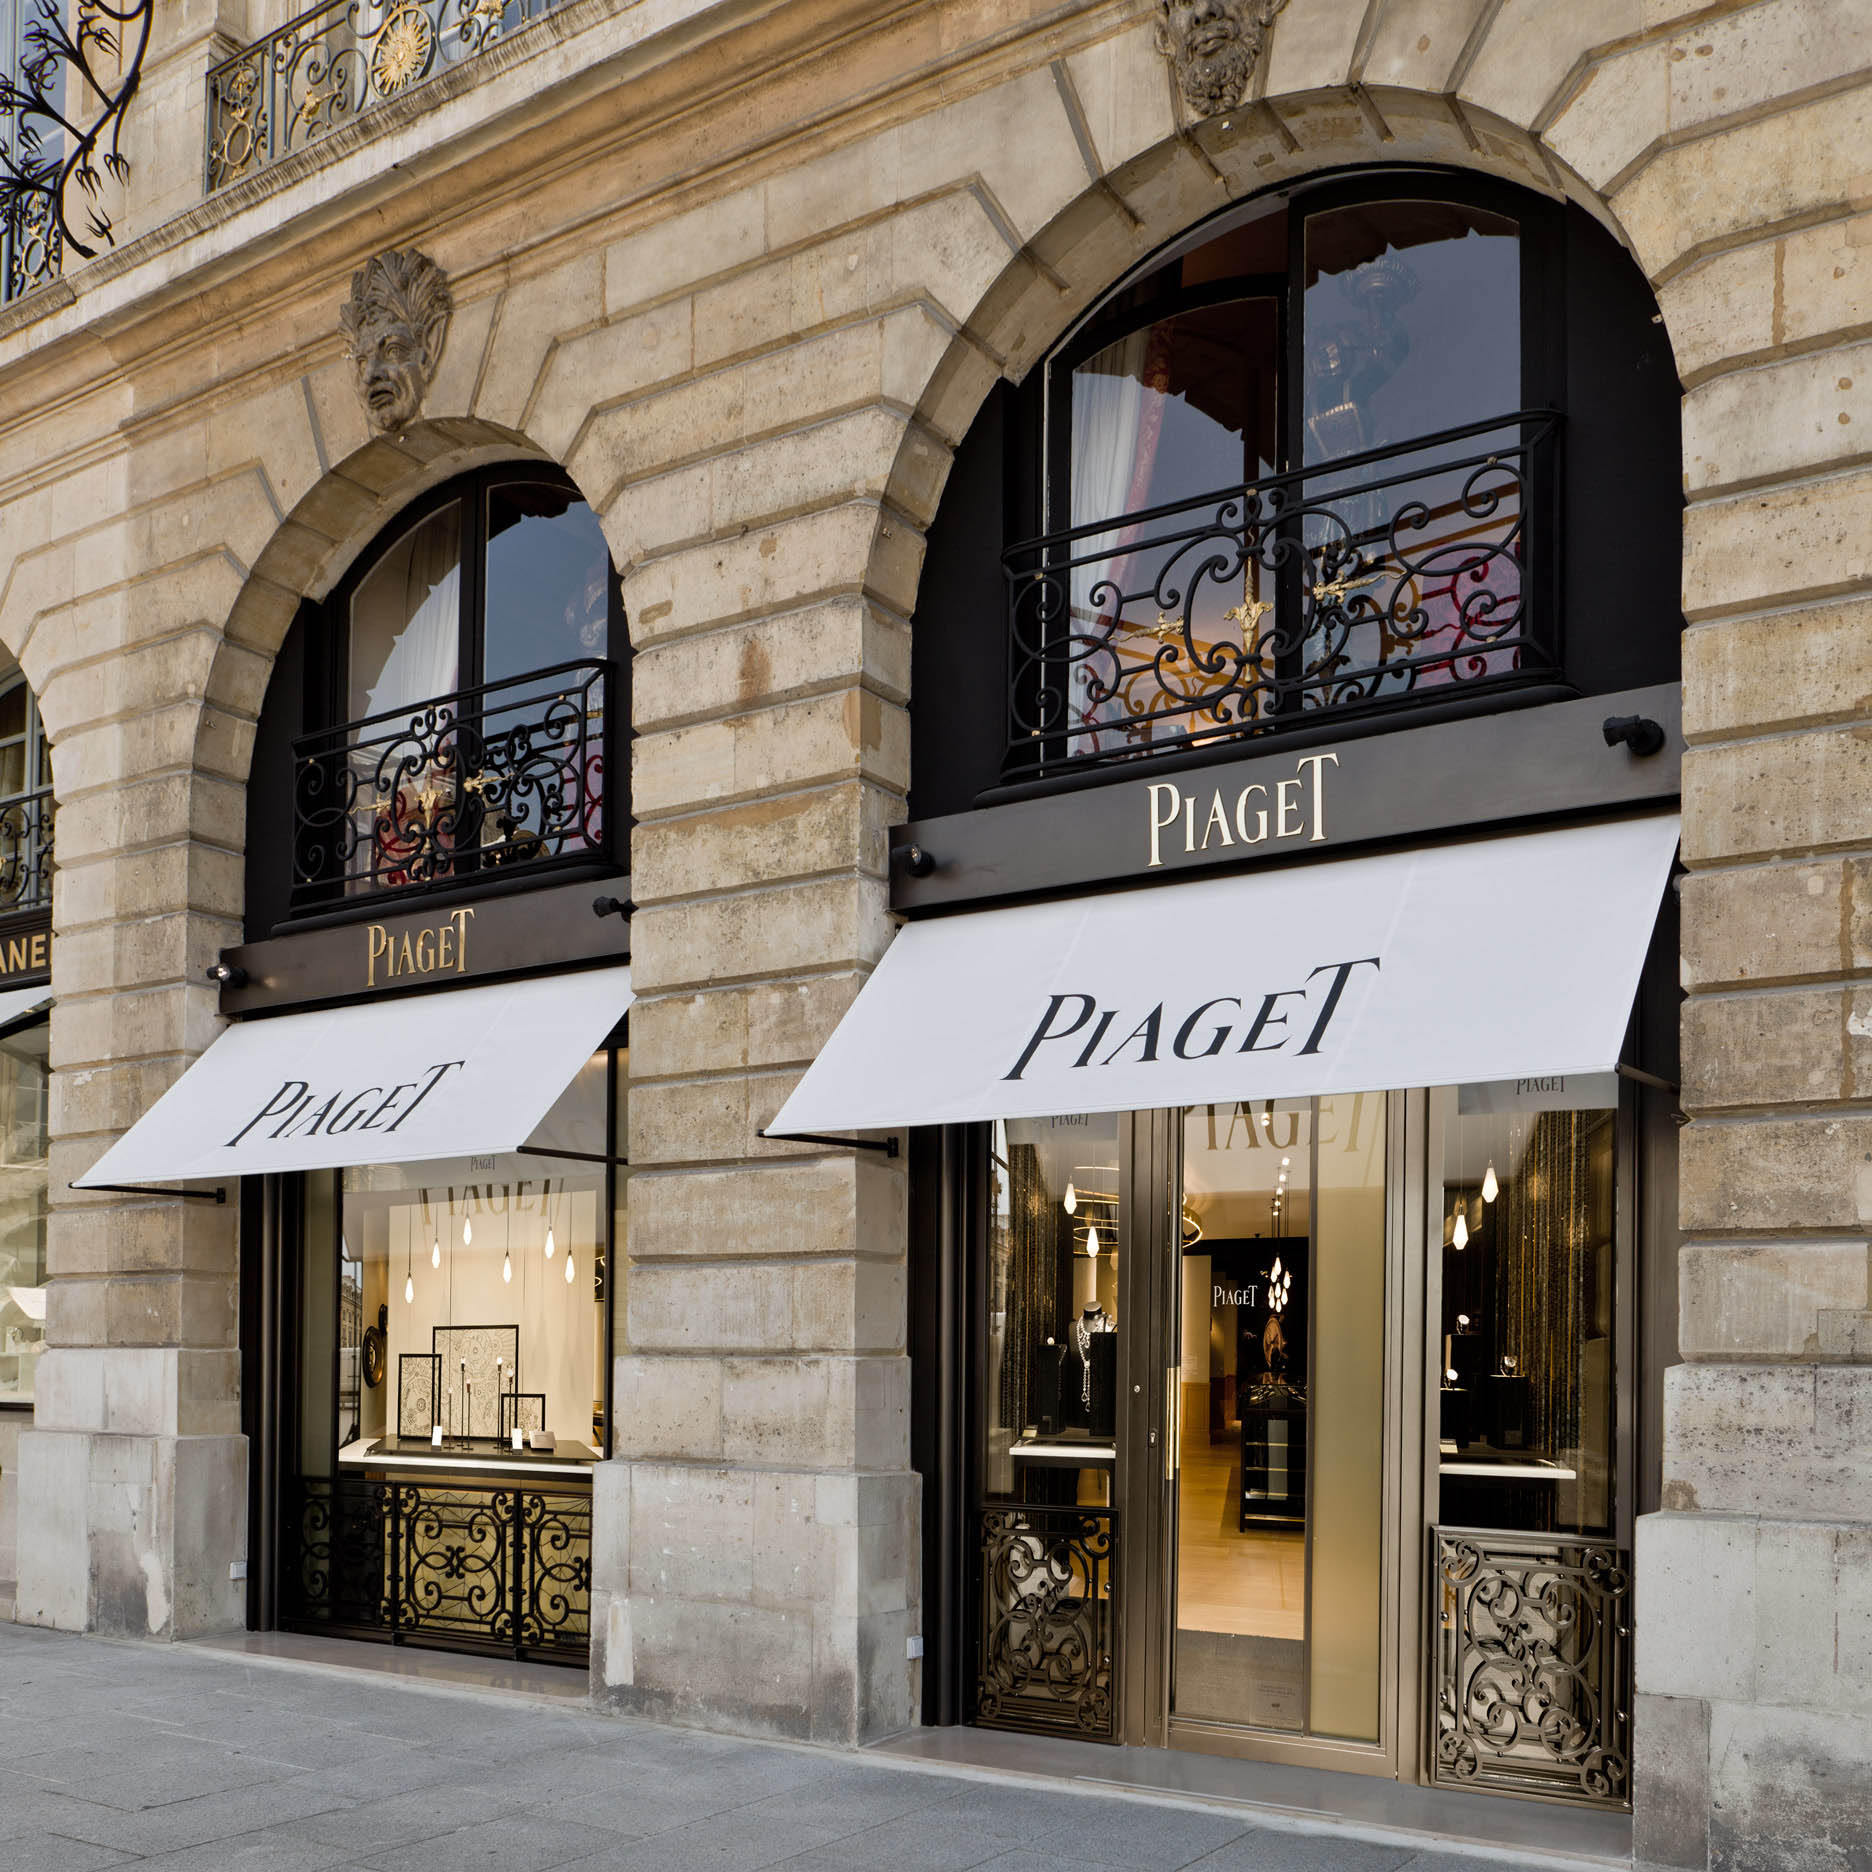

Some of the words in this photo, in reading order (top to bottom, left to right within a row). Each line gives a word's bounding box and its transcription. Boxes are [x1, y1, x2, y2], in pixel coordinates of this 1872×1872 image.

[1147, 753, 1339, 866] PIAGET
[367, 908, 475, 987] PIAGET
[1001, 957, 1380, 1080] PIAGET
[224, 1060, 465, 1147] PIAGET
[1213, 1285, 1258, 1307] PIAGET
